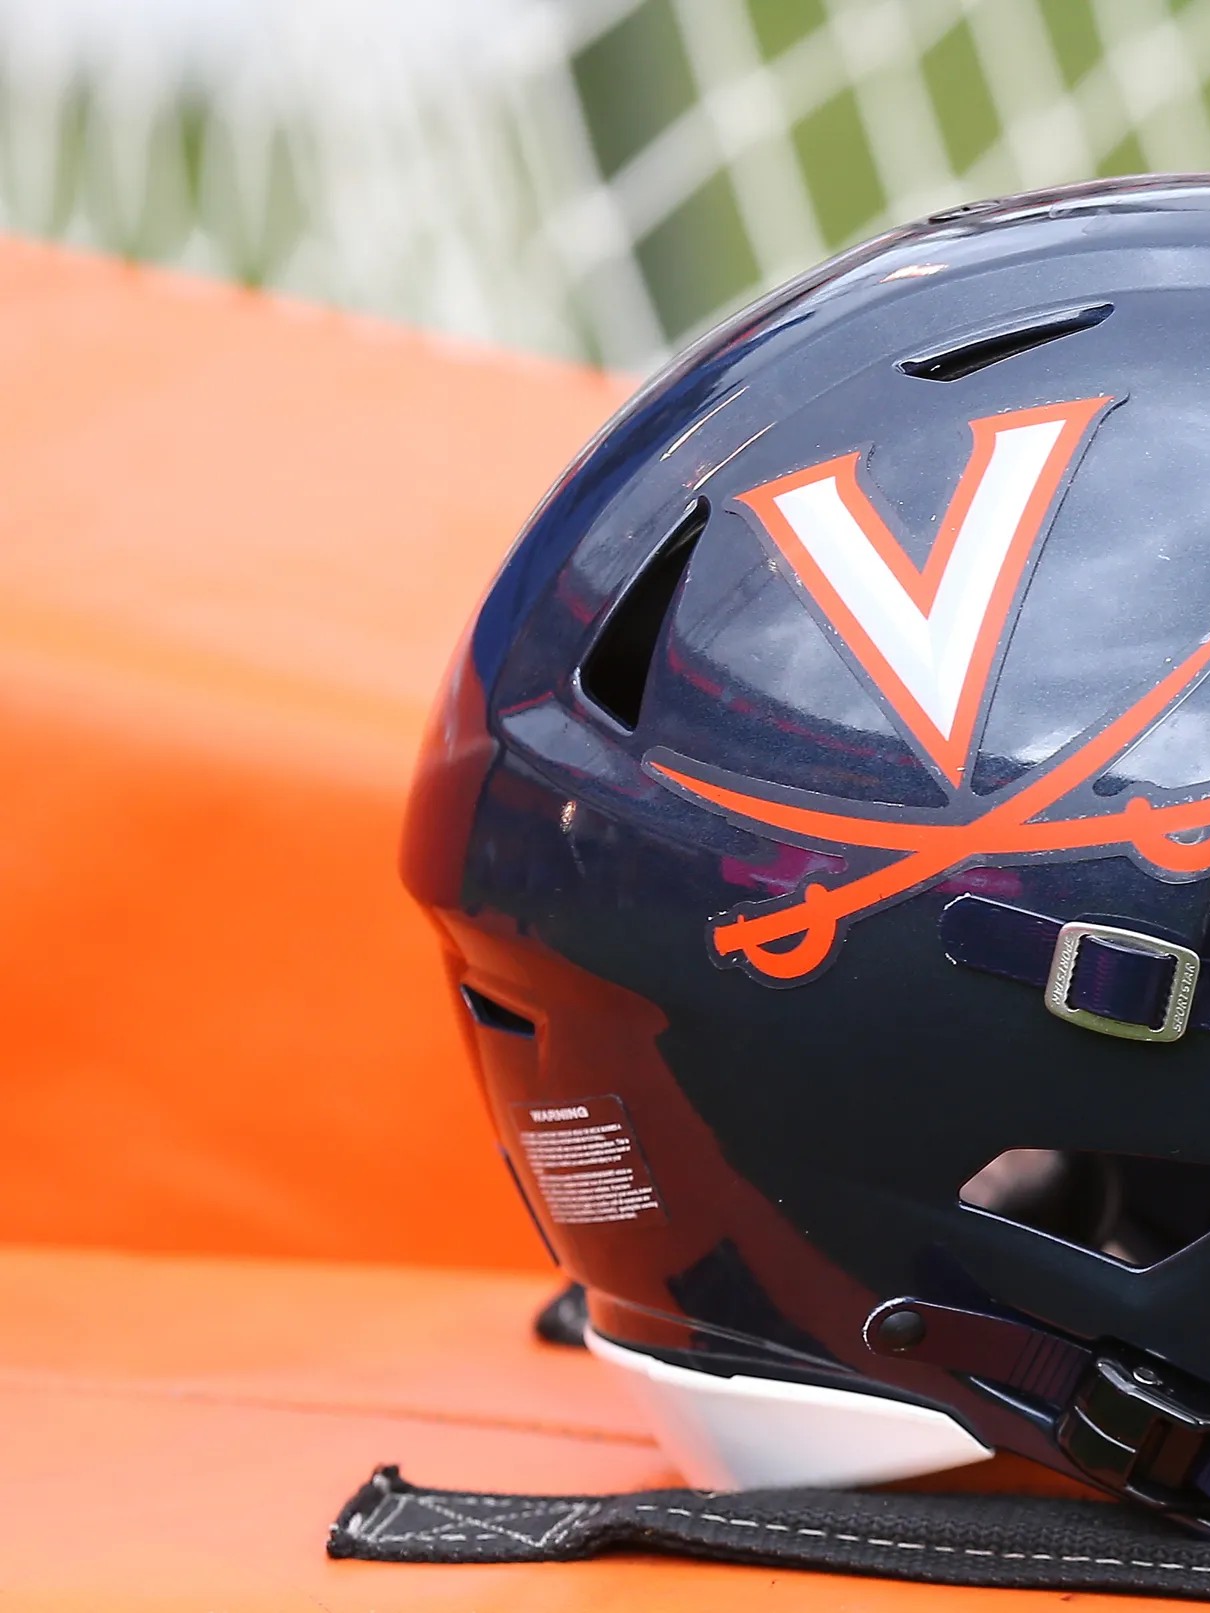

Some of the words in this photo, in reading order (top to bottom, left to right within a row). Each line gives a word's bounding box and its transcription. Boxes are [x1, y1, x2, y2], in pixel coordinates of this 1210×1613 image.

[732, 396, 1115, 790] V
[1051, 936, 1076, 1005] SPORTSTAR
[1172, 962, 1196, 1033] SPORTSTAR
[529, 1106, 590, 1122] WARNING
